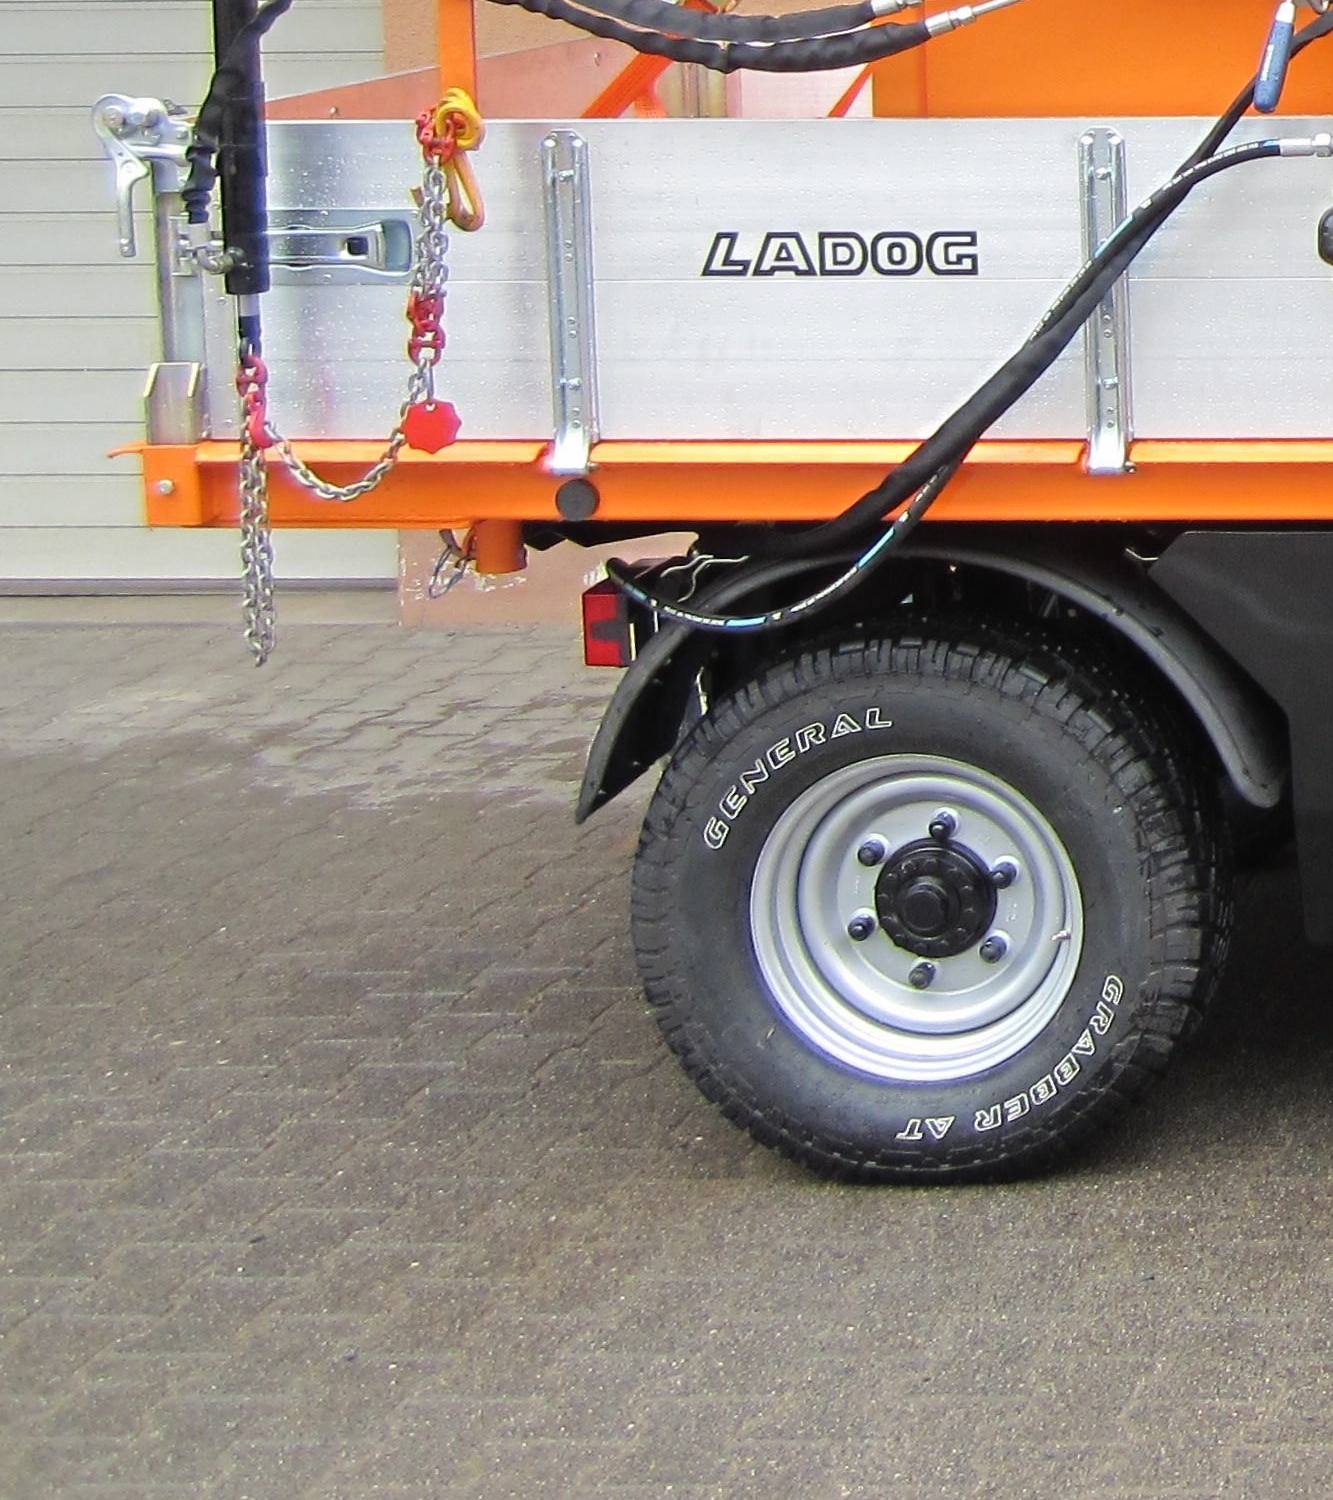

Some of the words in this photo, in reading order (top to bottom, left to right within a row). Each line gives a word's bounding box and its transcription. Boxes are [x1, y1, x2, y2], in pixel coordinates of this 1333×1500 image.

[700, 231, 979, 276] LADOG
[703, 707, 893, 850] GENERAL
[974, 974, 1125, 1132] GRABBER
[895, 1116, 956, 1141] AT
